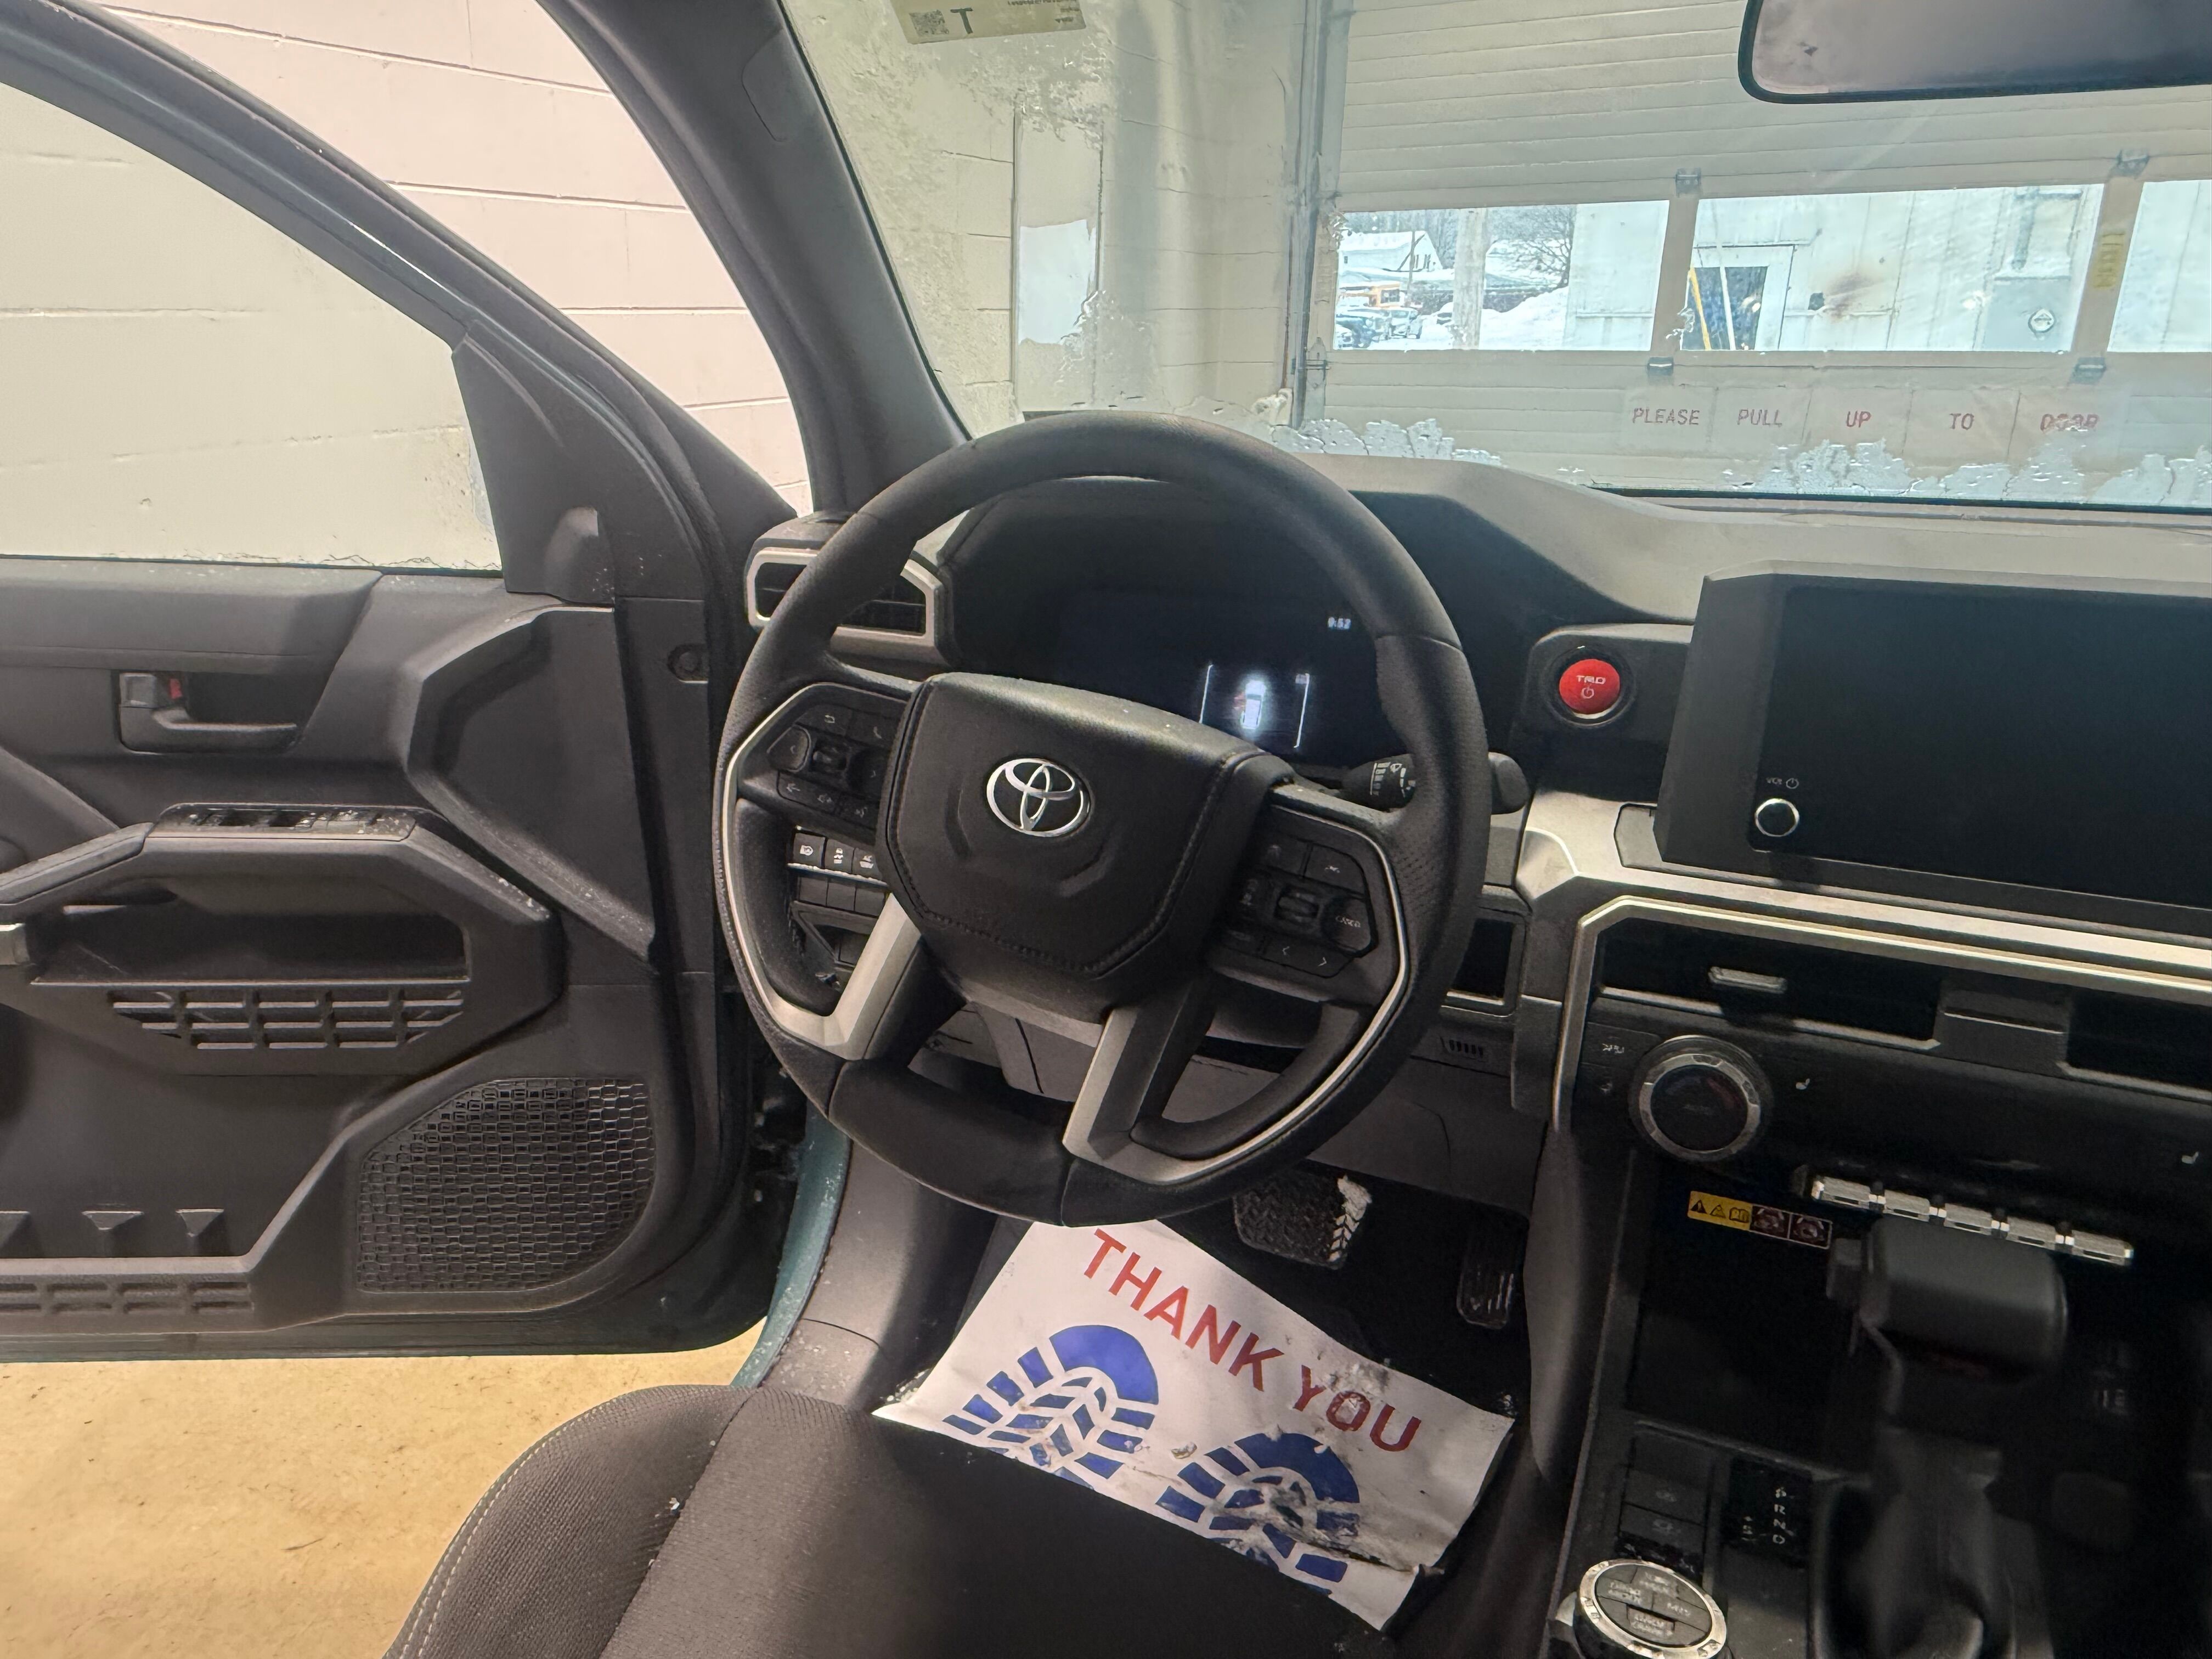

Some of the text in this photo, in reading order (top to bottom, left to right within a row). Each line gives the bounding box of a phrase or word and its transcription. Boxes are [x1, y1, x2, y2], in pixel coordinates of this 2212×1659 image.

[950, 8, 973, 34] T
[1632, 408, 1700, 425] PLEASE
[1736, 409, 1783, 426] PULL
[1845, 410, 1872, 428] UP
[1949, 413, 1975, 430] TO
[1576, 675, 1606, 685] TRD
[1084, 1228, 1422, 1452] THANK YOU
